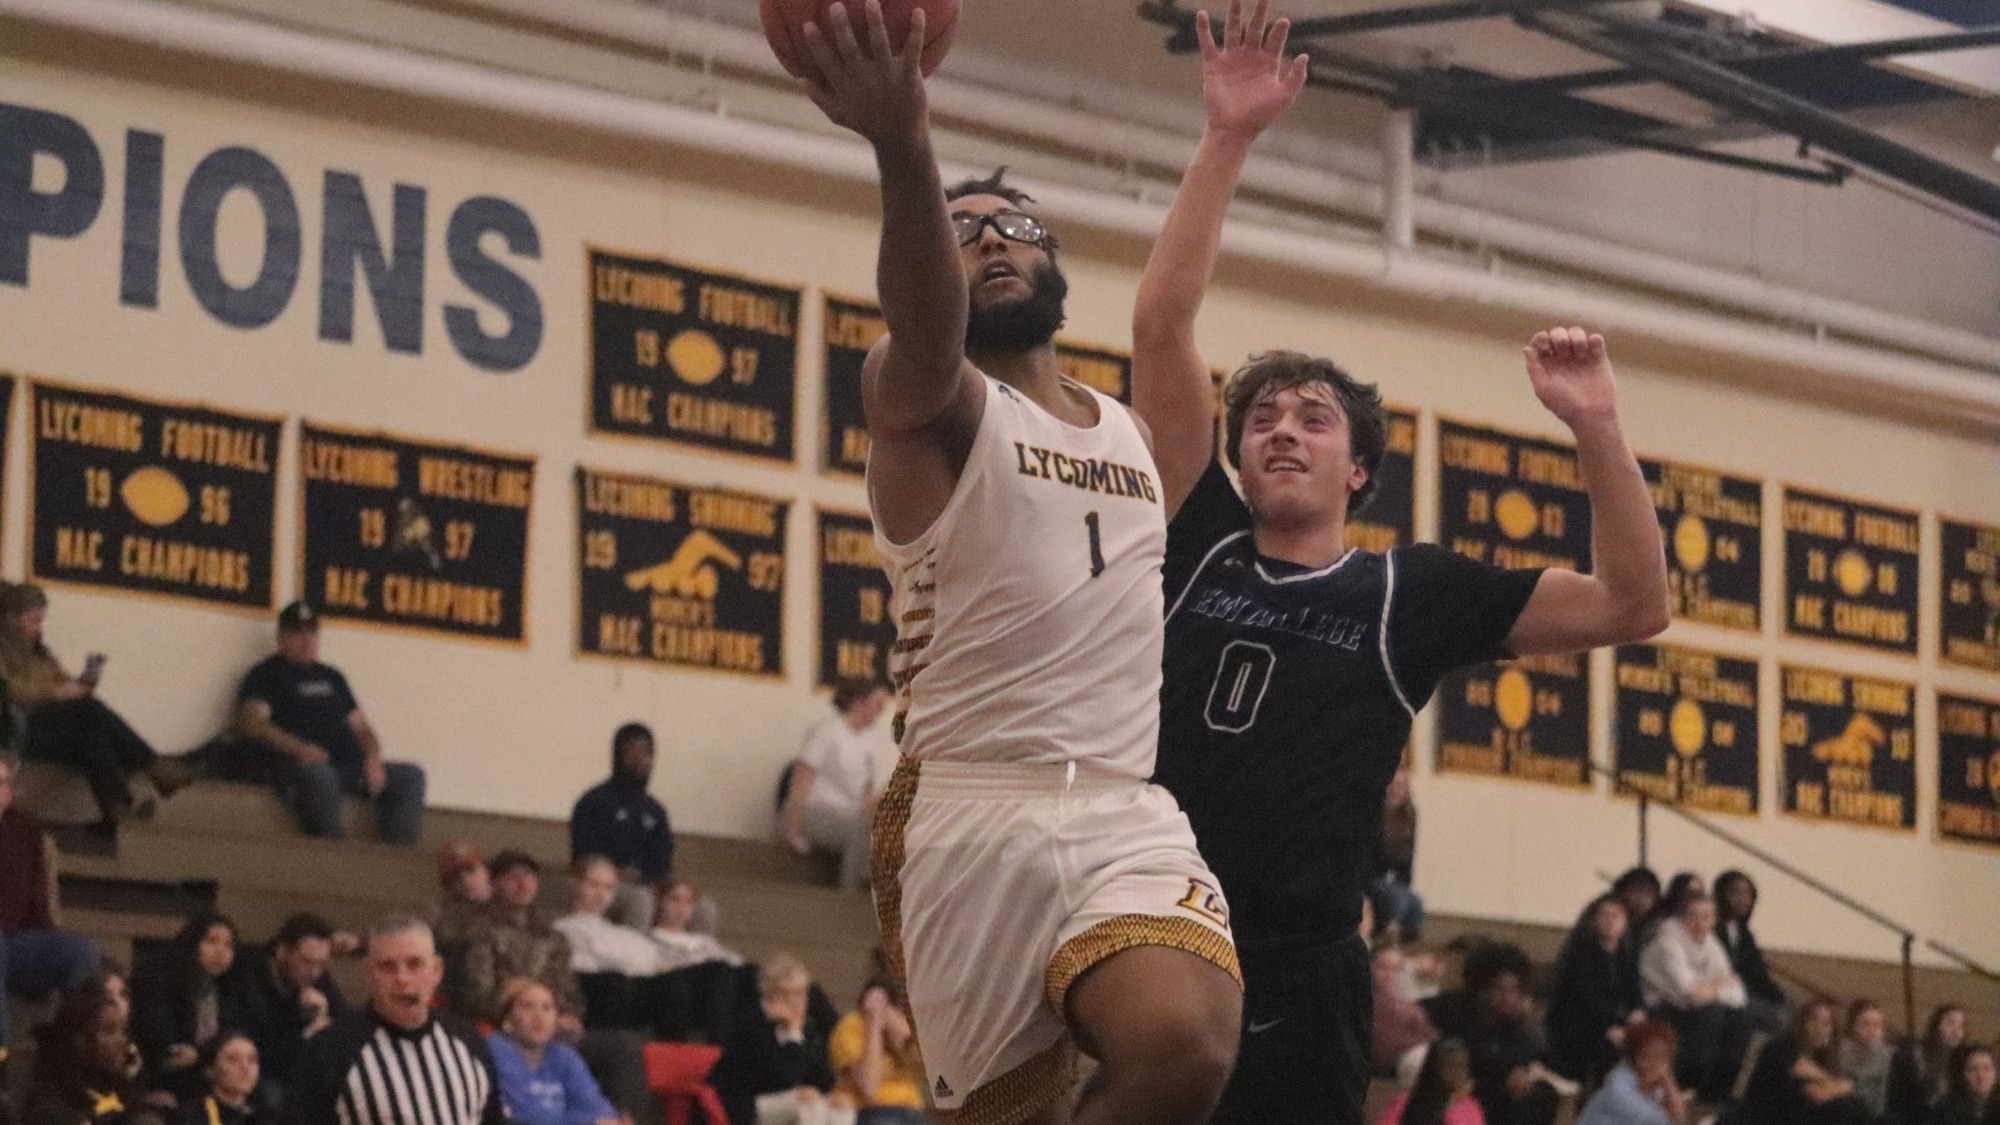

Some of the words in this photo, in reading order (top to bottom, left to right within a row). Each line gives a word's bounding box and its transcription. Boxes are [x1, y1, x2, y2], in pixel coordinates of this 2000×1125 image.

[0, 103, 544, 374] PIONS
[42, 403, 142, 452] LYCOMING
[163, 422, 269, 473] FOOTBALL
[85, 468, 110, 508] 19
[1014, 441, 1157, 503] LYCOMING
[122, 536, 249, 591] CHAMPIONS
[1084, 511, 1105, 578] 1
[384, 575, 501, 626] CHAMPIONS
[1203, 639, 1276, 733] 0
